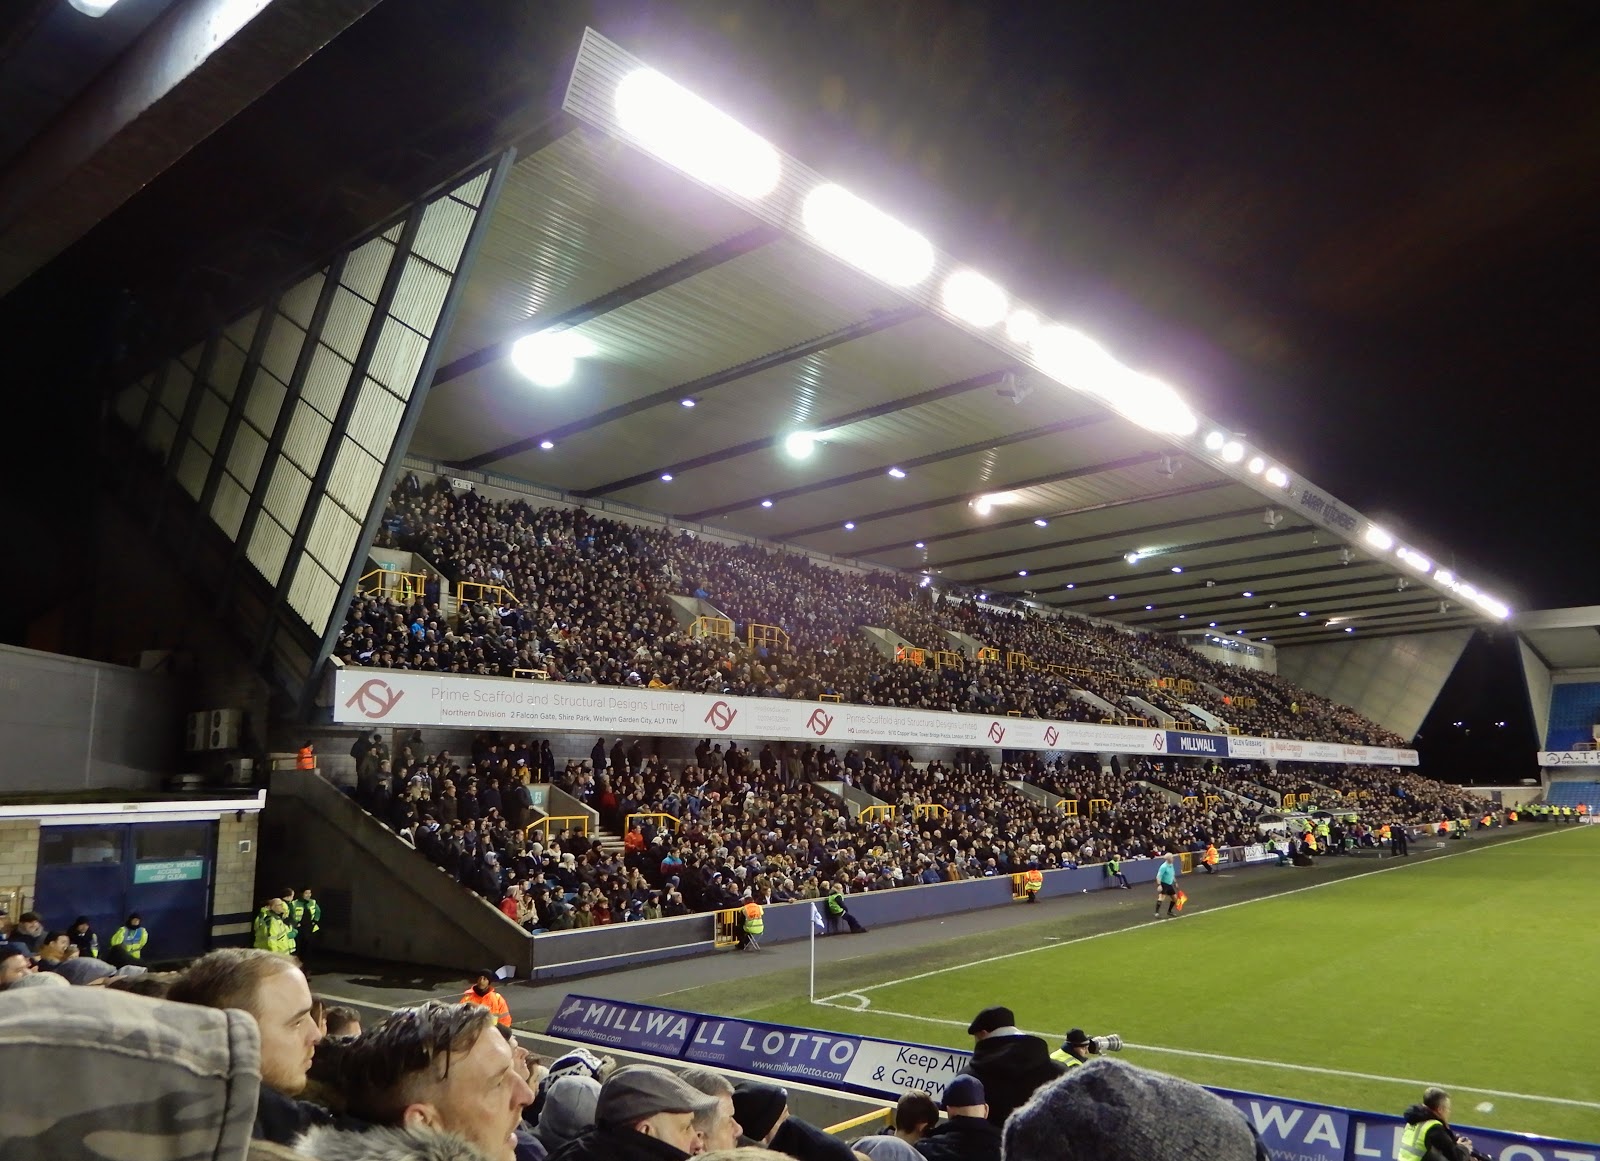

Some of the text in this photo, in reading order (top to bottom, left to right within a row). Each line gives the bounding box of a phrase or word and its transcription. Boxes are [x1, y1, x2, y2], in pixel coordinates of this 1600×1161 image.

[431, 687, 685, 712] Prime Scaffold and Structural Designs Limited
[442, 709, 475, 717] Northern
[477, 710, 505, 718] Division
[576, 714, 591, 722] Park,
[846, 714, 866, 724] Prime
[867, 715, 892, 725] Scaffold
[894, 717, 906, 726] and
[907, 717, 934, 728] Structural
[1180, 736, 1217, 753] MILLWALL
[137, 863, 174, 871] EMERGENCY
[551, 1024, 622, 1043] www.millwalllotto.com
[740, 1027, 855, 1065] LOTTO
[896, 1047, 966, 1073] Keep All
[752, 1060, 842, 1081] www.millwalllotto.com
[872, 1066, 885, 1081] &
